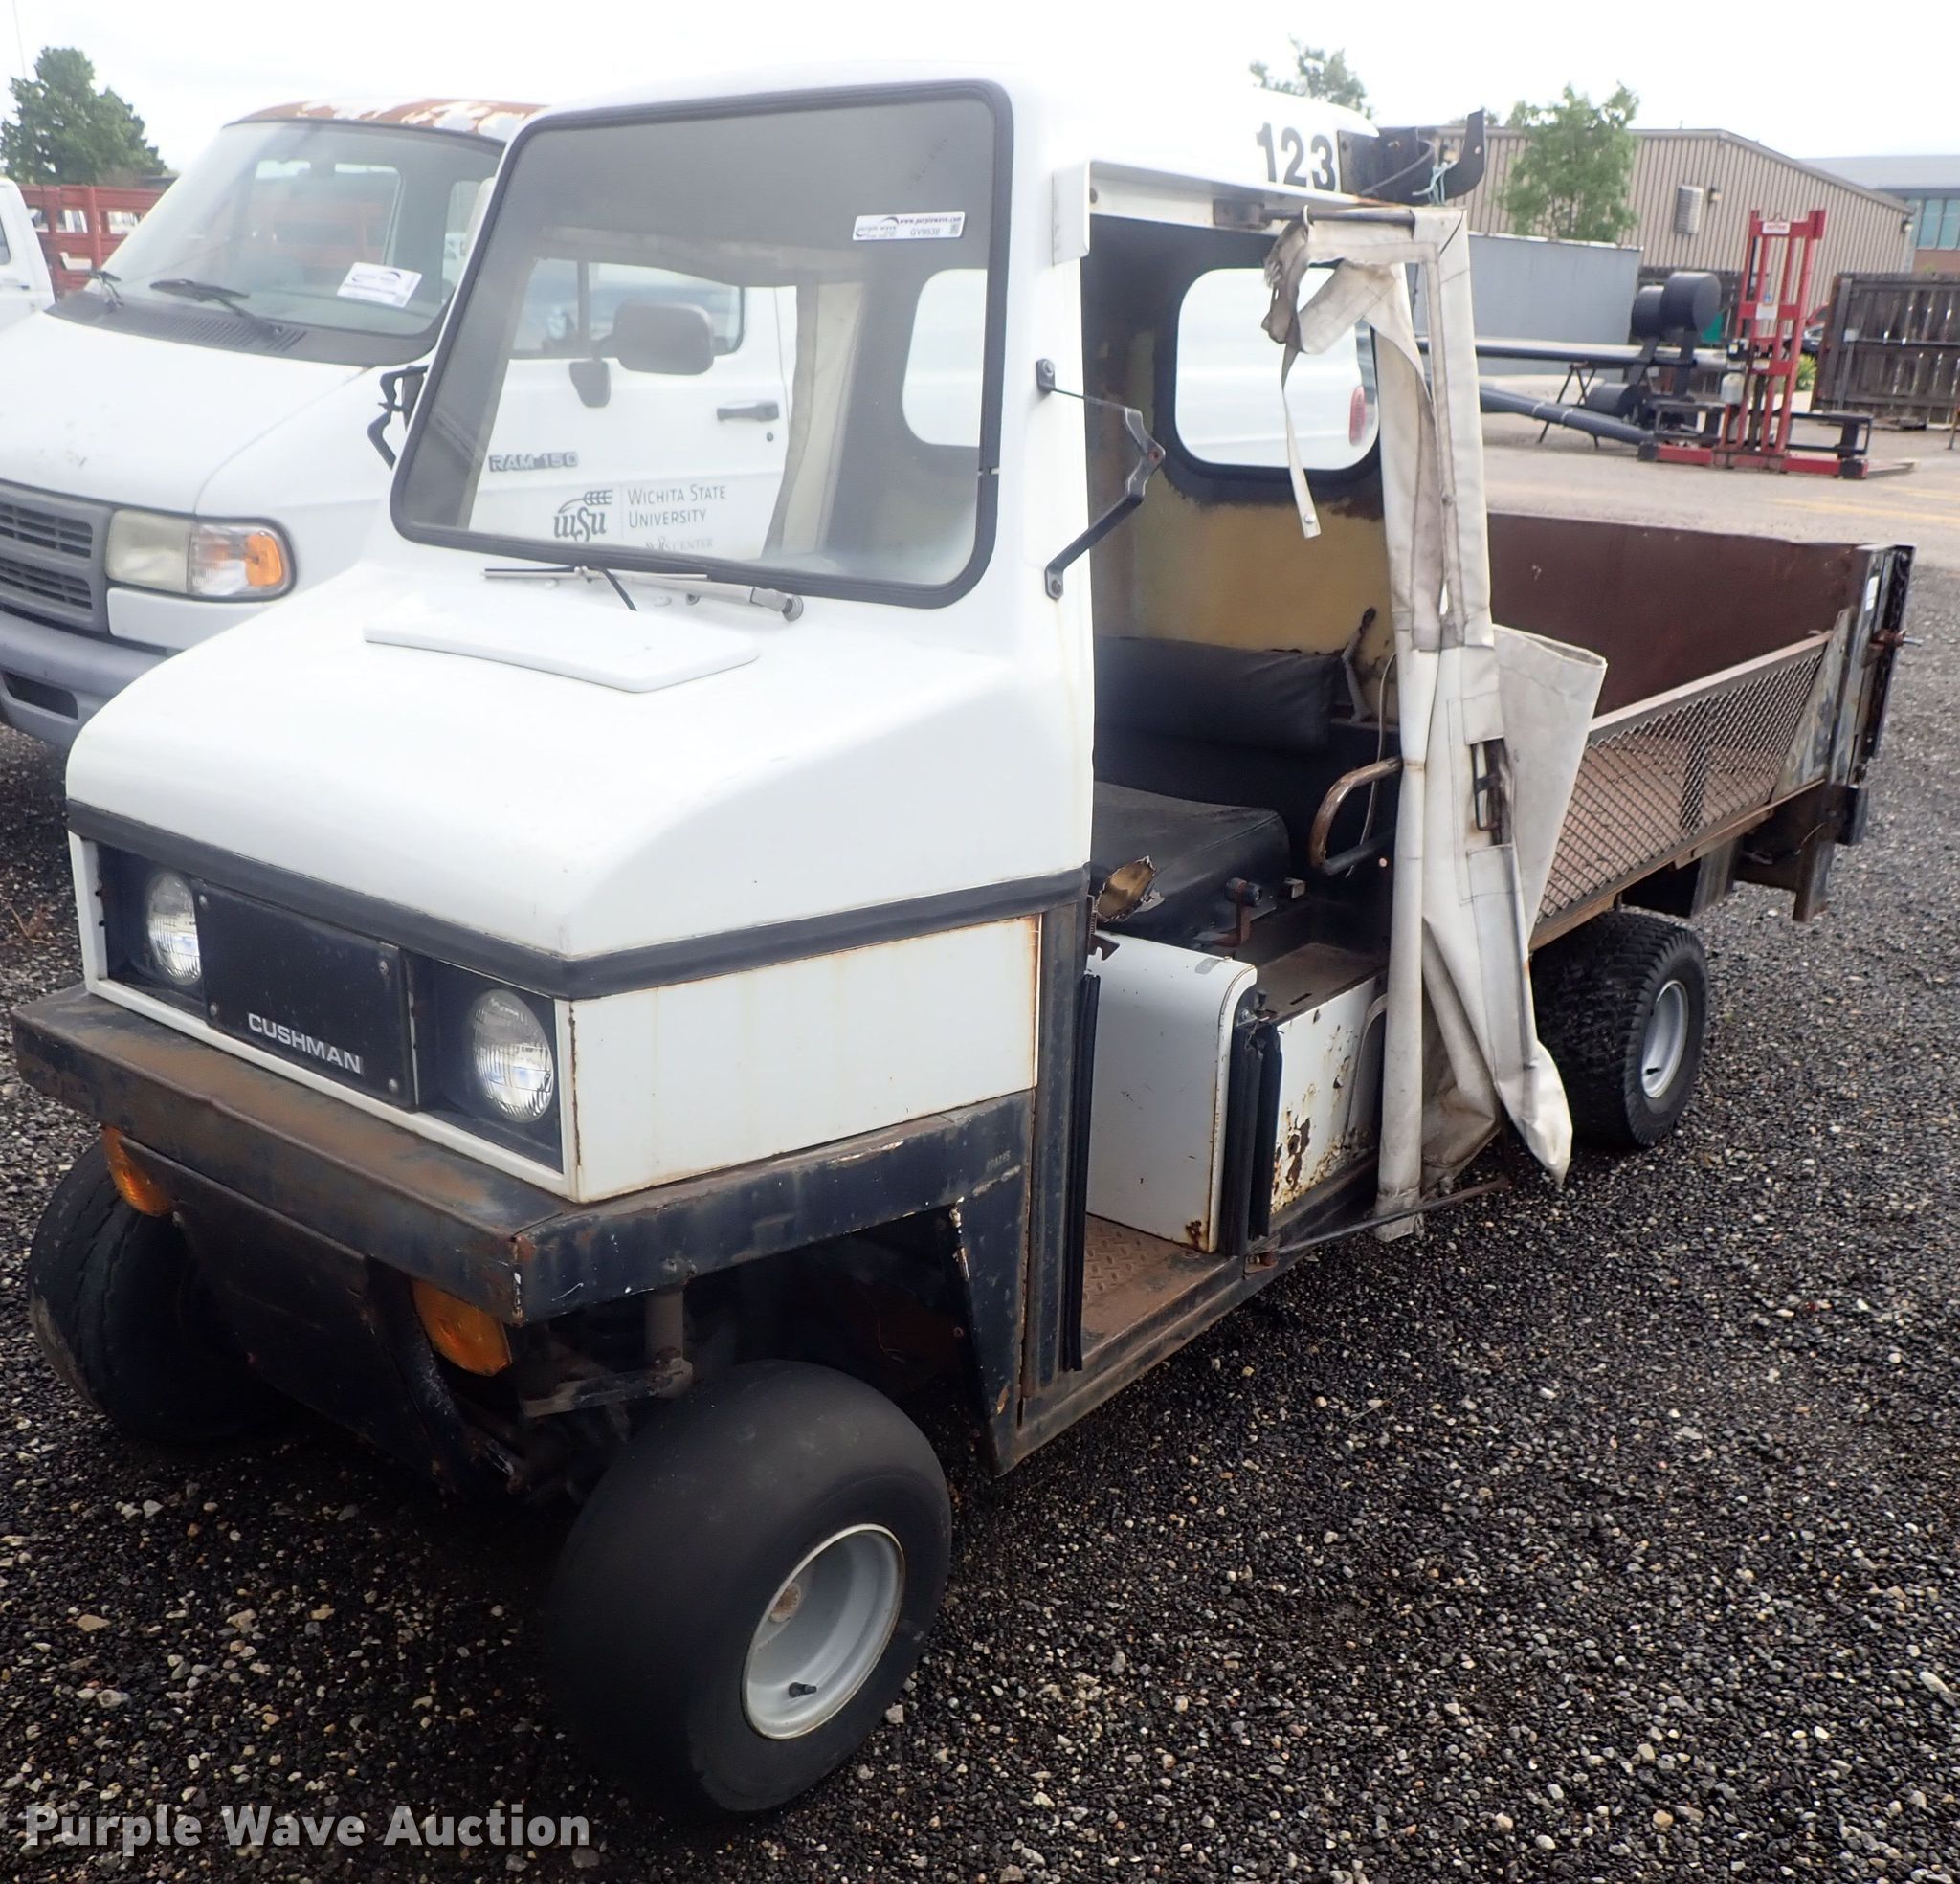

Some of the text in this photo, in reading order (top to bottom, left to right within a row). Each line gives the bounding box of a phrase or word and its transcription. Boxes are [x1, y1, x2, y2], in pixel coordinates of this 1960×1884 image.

[1257, 122, 1337, 191] 123
[489, 452, 579, 472] RAM 150
[248, 1012, 362, 1074] CUSHMAN
